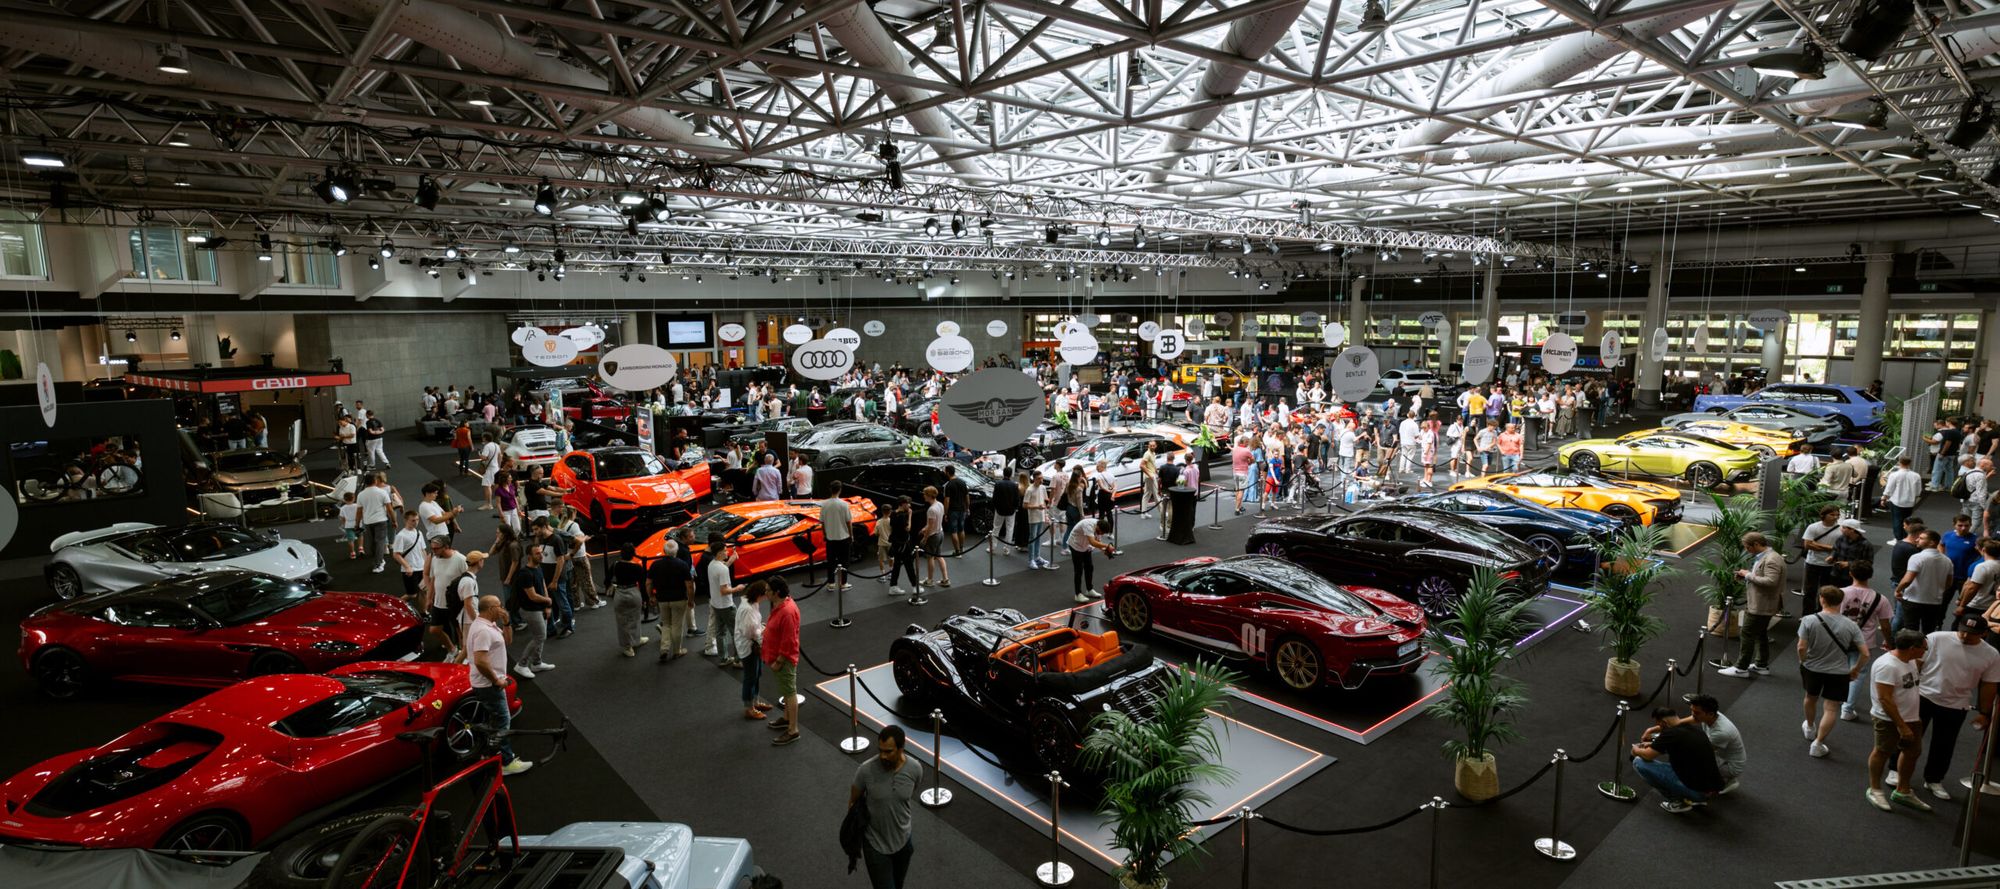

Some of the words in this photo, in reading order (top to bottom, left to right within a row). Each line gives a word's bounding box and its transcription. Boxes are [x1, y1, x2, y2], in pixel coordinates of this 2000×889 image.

[1544, 348, 1572, 357] McLaren
[1345, 370, 1367, 378] BENTLEY
[132, 375, 190, 391] BERTONE
[252, 377, 308, 390] GB110
[978, 407, 1013, 417] MORGAN
[1241, 622, 1266, 656] 01
